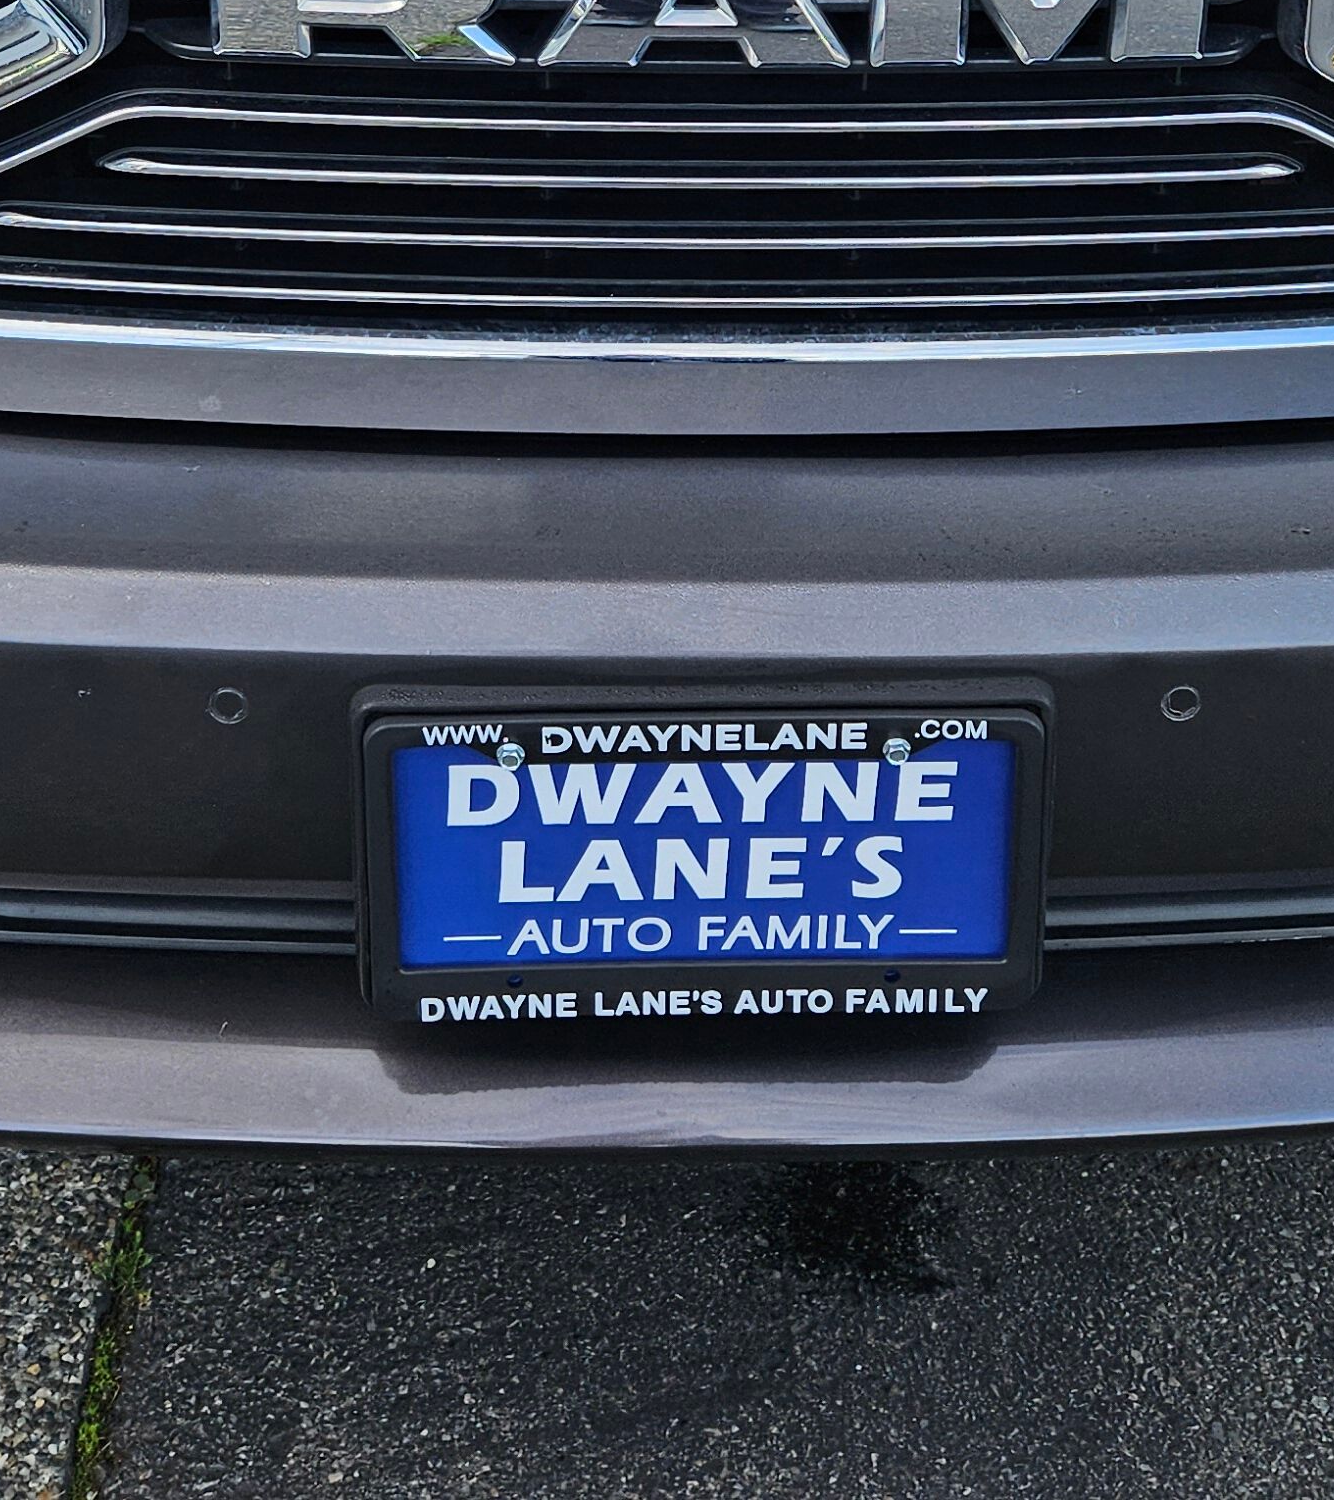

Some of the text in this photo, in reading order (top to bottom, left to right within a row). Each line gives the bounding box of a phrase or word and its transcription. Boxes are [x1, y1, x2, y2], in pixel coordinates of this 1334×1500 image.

[541, 722, 868, 755] DWAYNELANE
[447, 761, 959, 827] DWAYNE
[498, 836, 904, 903] LANE'S
[507, 913, 895, 956] AUTO FAMILY
[420, 987, 989, 1023] DWAYNE LANE'S AUTO FAMILY
